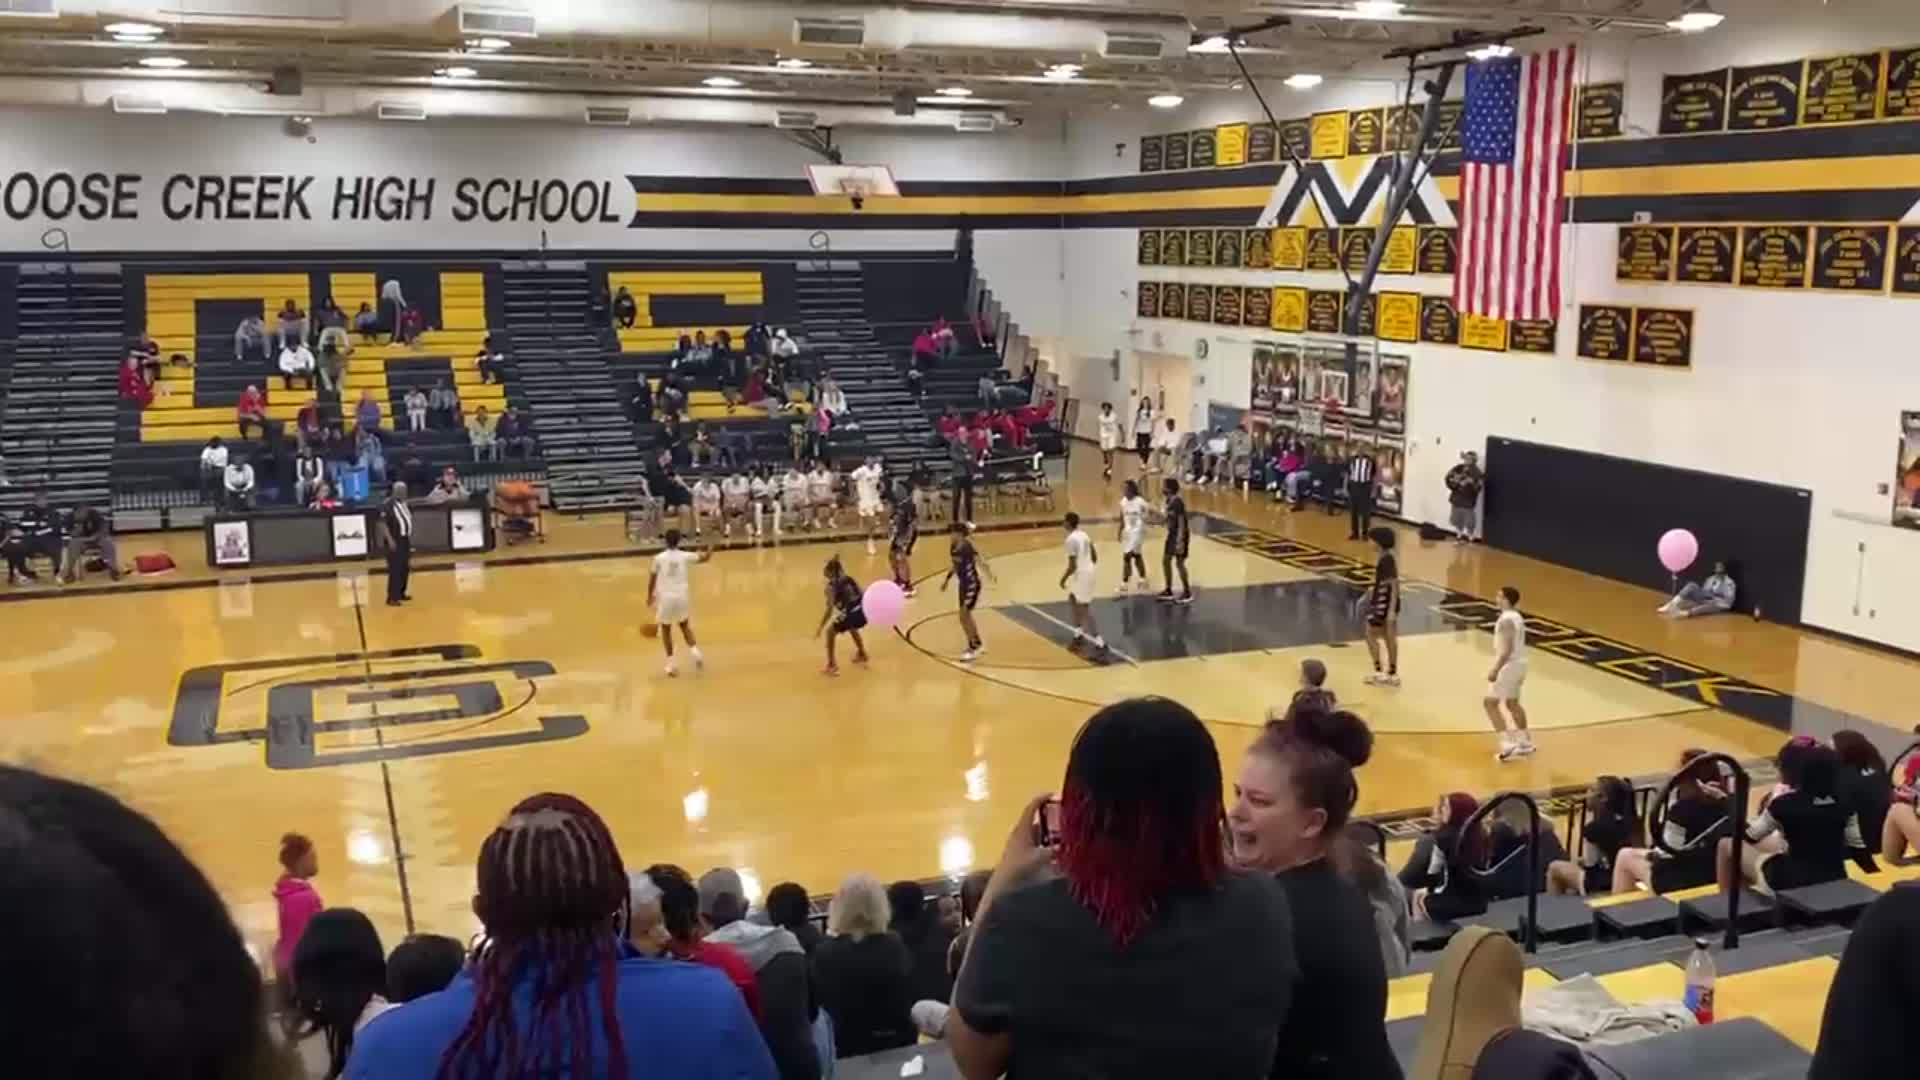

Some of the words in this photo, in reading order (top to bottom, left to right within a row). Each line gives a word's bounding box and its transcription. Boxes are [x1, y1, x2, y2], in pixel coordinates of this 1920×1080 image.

[0, 172, 142, 220] OOSE
[160, 173, 315, 221] CREEK
[331, 175, 435, 221] HIGH
[451, 178, 621, 223] SCHOOL
